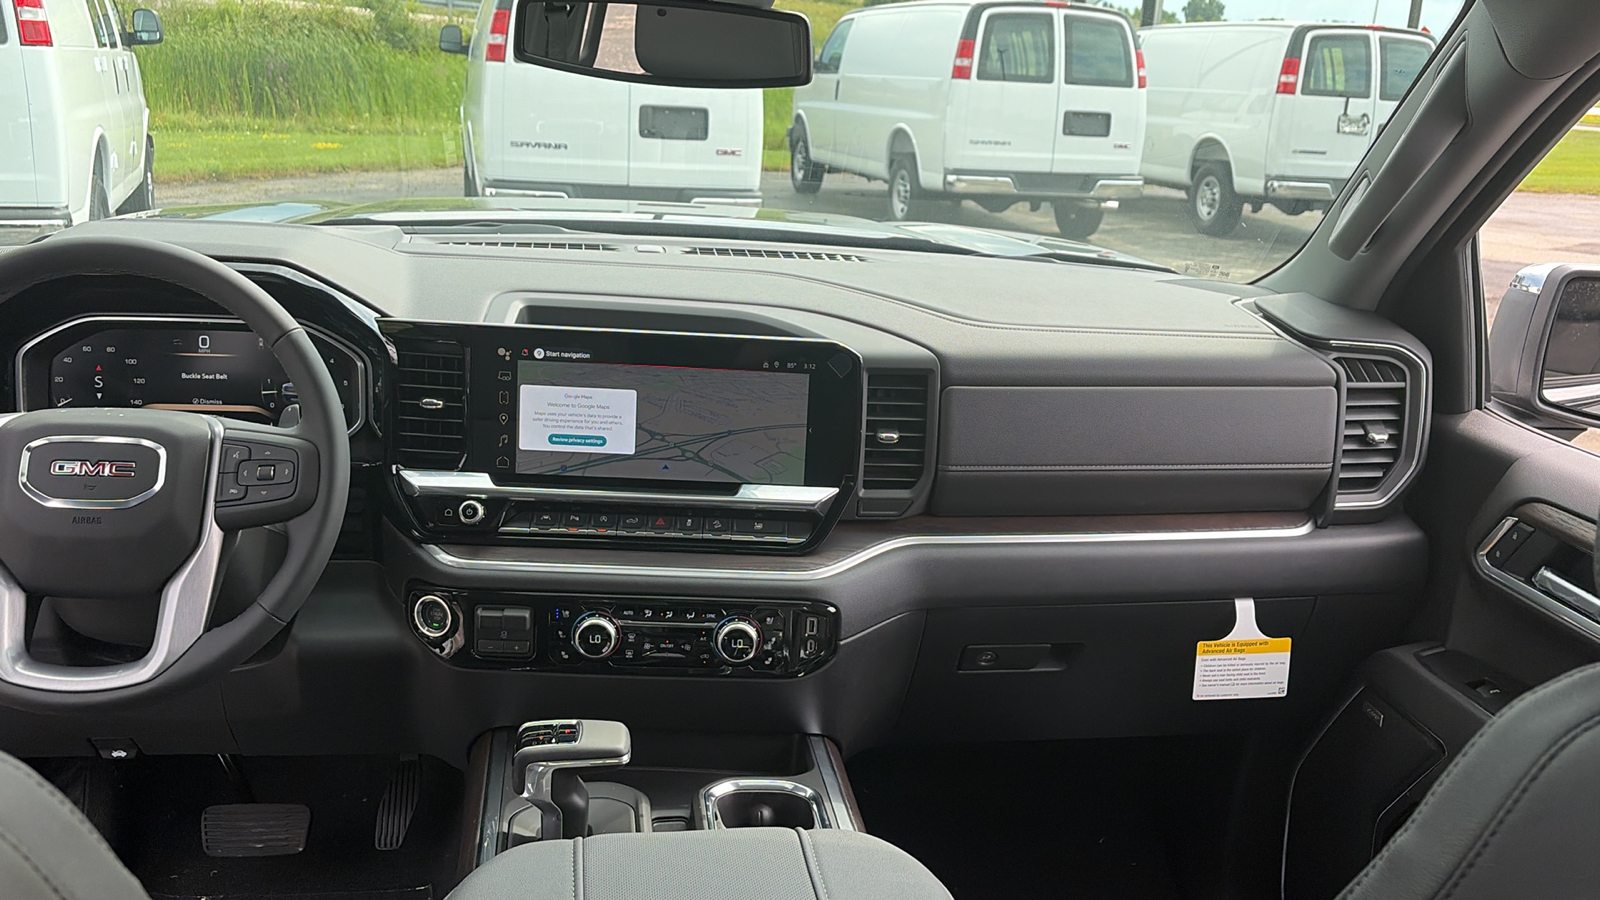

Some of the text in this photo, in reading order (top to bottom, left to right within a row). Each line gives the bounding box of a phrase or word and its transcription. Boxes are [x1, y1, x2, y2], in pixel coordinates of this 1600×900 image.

[510, 140, 568, 150] SAVANA
[198, 335, 210, 349] 0
[560, 351, 590, 360] navigation
[94, 375, 104, 388] S
[50, 460, 136, 476] GMC
[590, 634, 601, 644] LO
